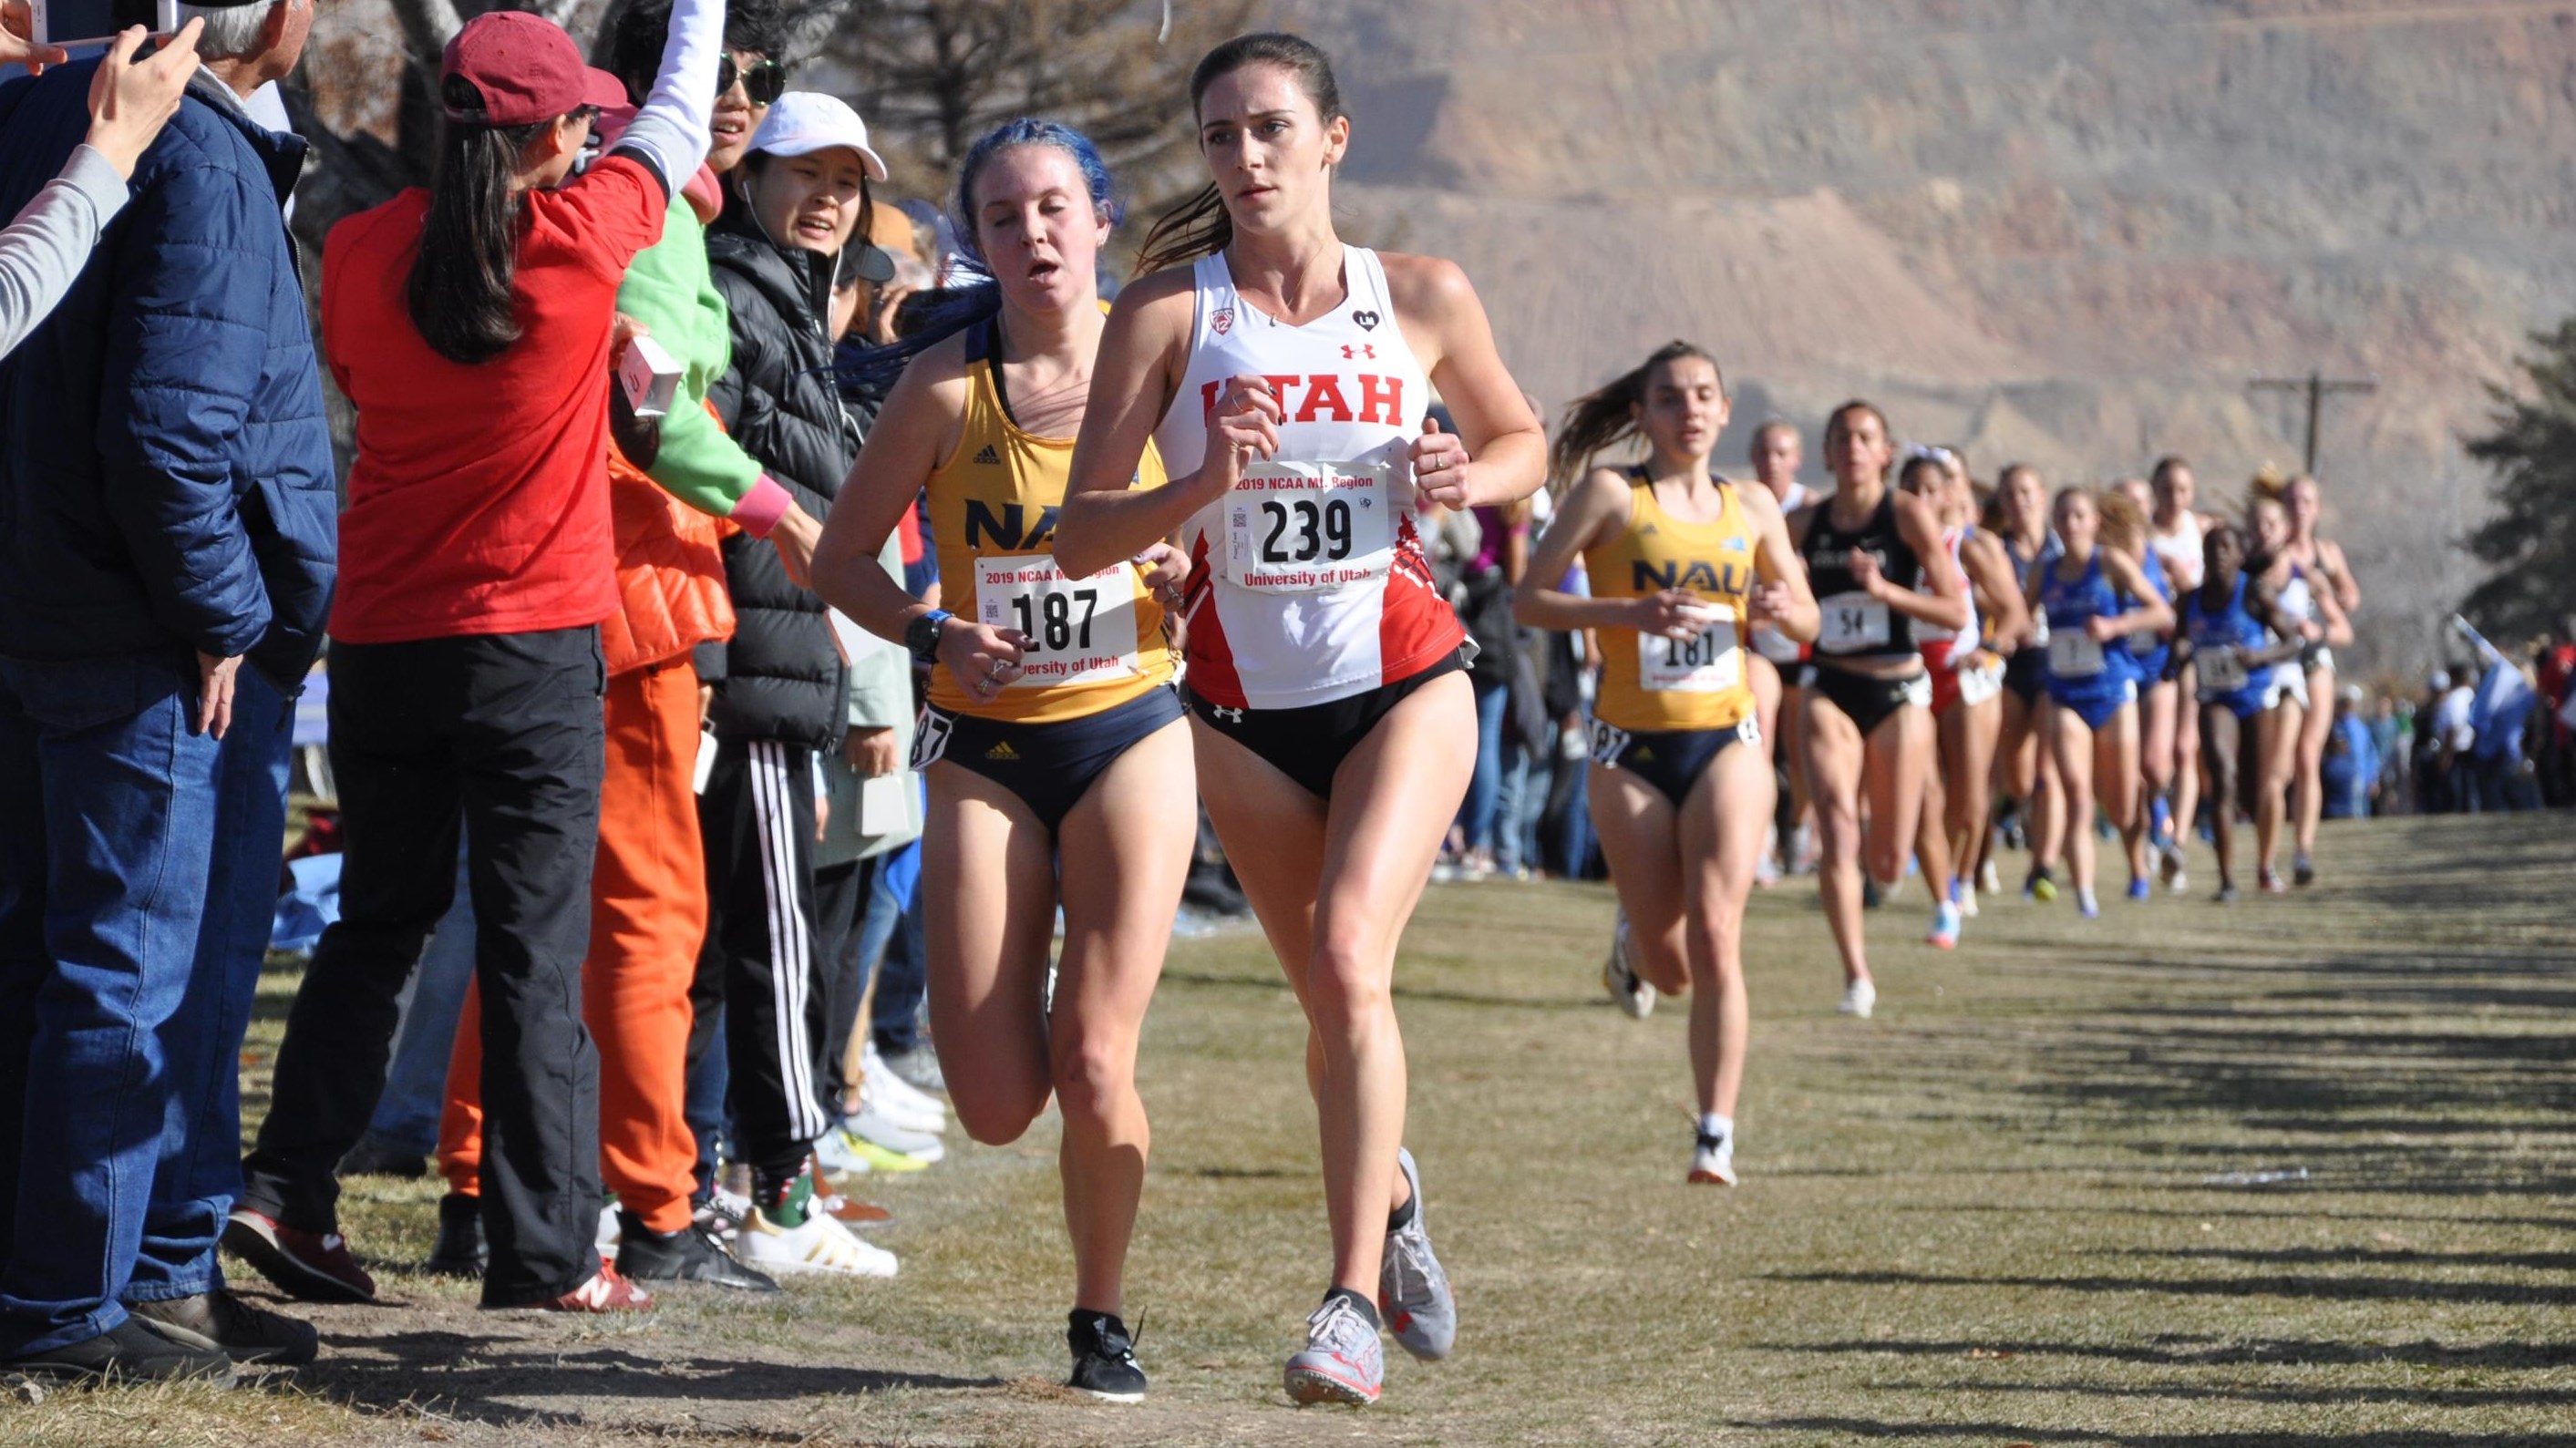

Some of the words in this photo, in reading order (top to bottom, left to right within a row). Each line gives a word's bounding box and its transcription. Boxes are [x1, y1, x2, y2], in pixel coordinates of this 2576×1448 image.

[1236, 478, 1264, 490] 2019
[1269, 477, 1303, 489] NCAA
[1332, 476, 1373, 490] Region
[965, 499, 1060, 549] NA
[1262, 499, 1352, 562] 239
[986, 572, 1014, 584] 2019
[1018, 569, 1053, 581] NCAA
[1244, 572, 1315, 587] University
[1321, 570, 1335, 582] of
[1339, 569, 1371, 582] Utah
[1632, 559, 1747, 595] NAU
[1012, 589, 1097, 652] 187
[1072, 657, 1086, 673] of
[1089, 655, 1119, 670] Utah
[1664, 632, 1714, 667] 181
